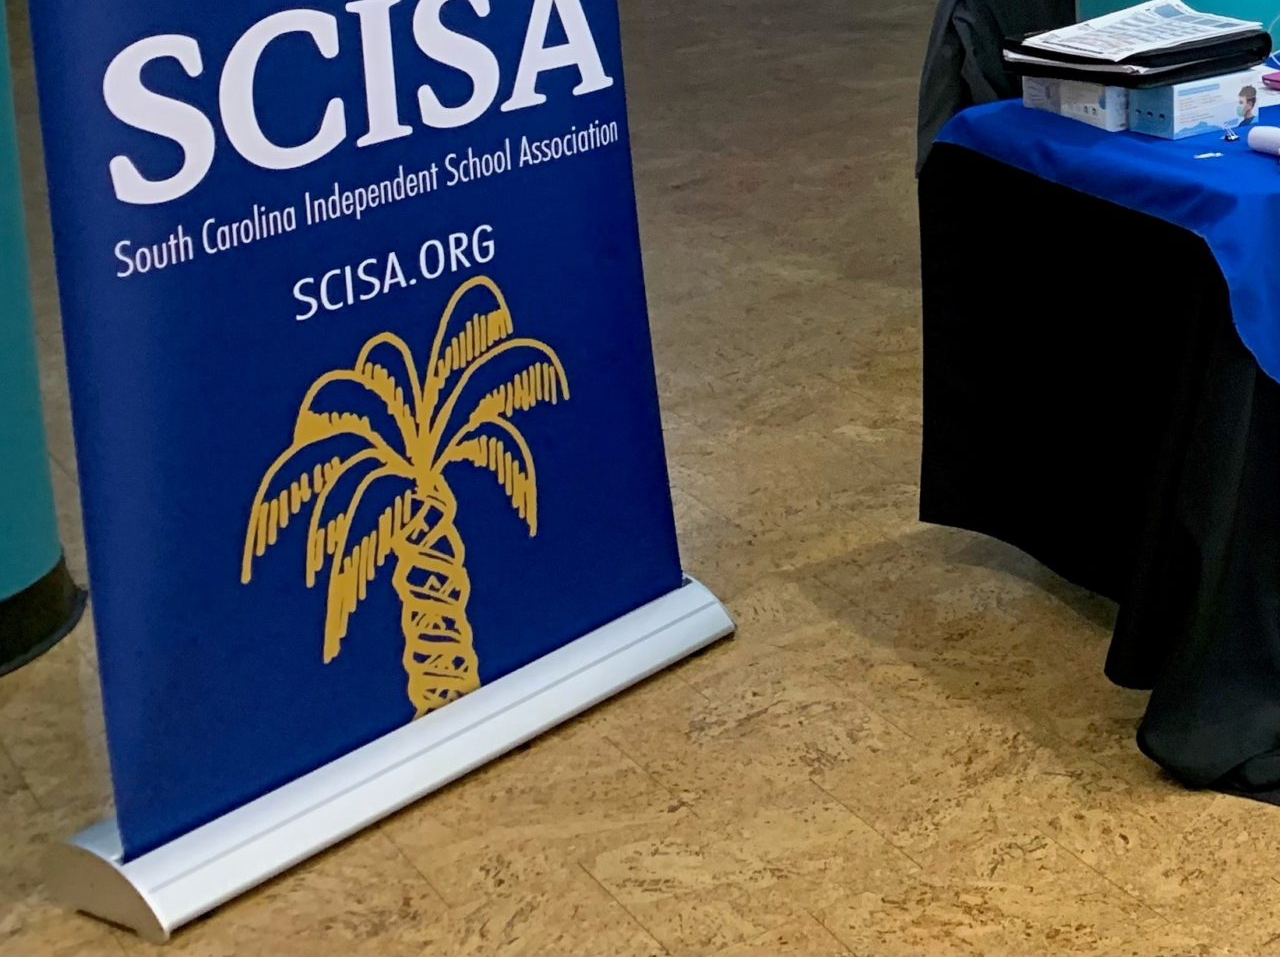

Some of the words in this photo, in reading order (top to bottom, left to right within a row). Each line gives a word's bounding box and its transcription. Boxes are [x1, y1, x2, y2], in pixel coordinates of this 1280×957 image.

[114, 224, 194, 278] South
[202, 204, 297, 254] Carolina
[305, 165, 438, 226] Independent
[444, 138, 512, 187] School
[519, 120, 618, 168] Association
[292, 223, 496, 322] SCISA.ORG
